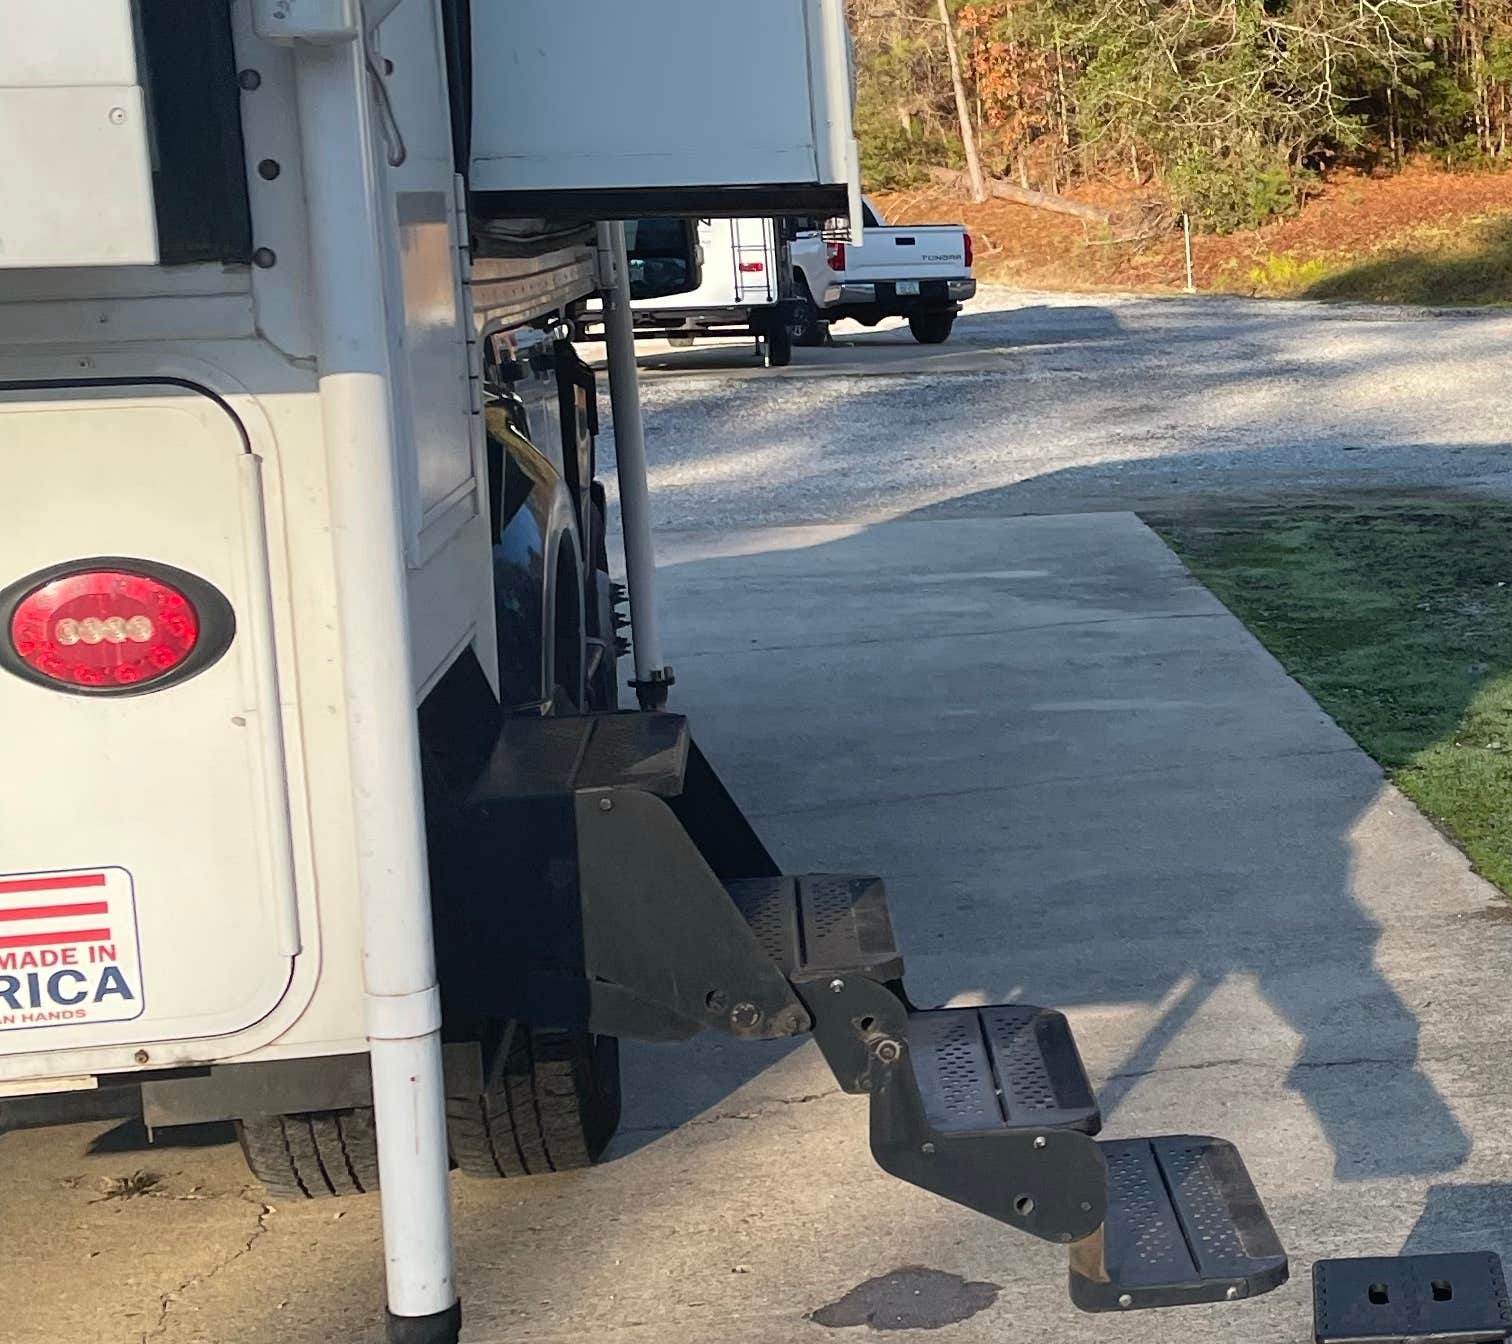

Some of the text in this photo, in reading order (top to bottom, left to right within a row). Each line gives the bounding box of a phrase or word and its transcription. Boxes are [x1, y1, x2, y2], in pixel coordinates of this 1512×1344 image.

[0, 944, 118, 970] MADE IN
[21, 1009, 87, 1023] HANDS
